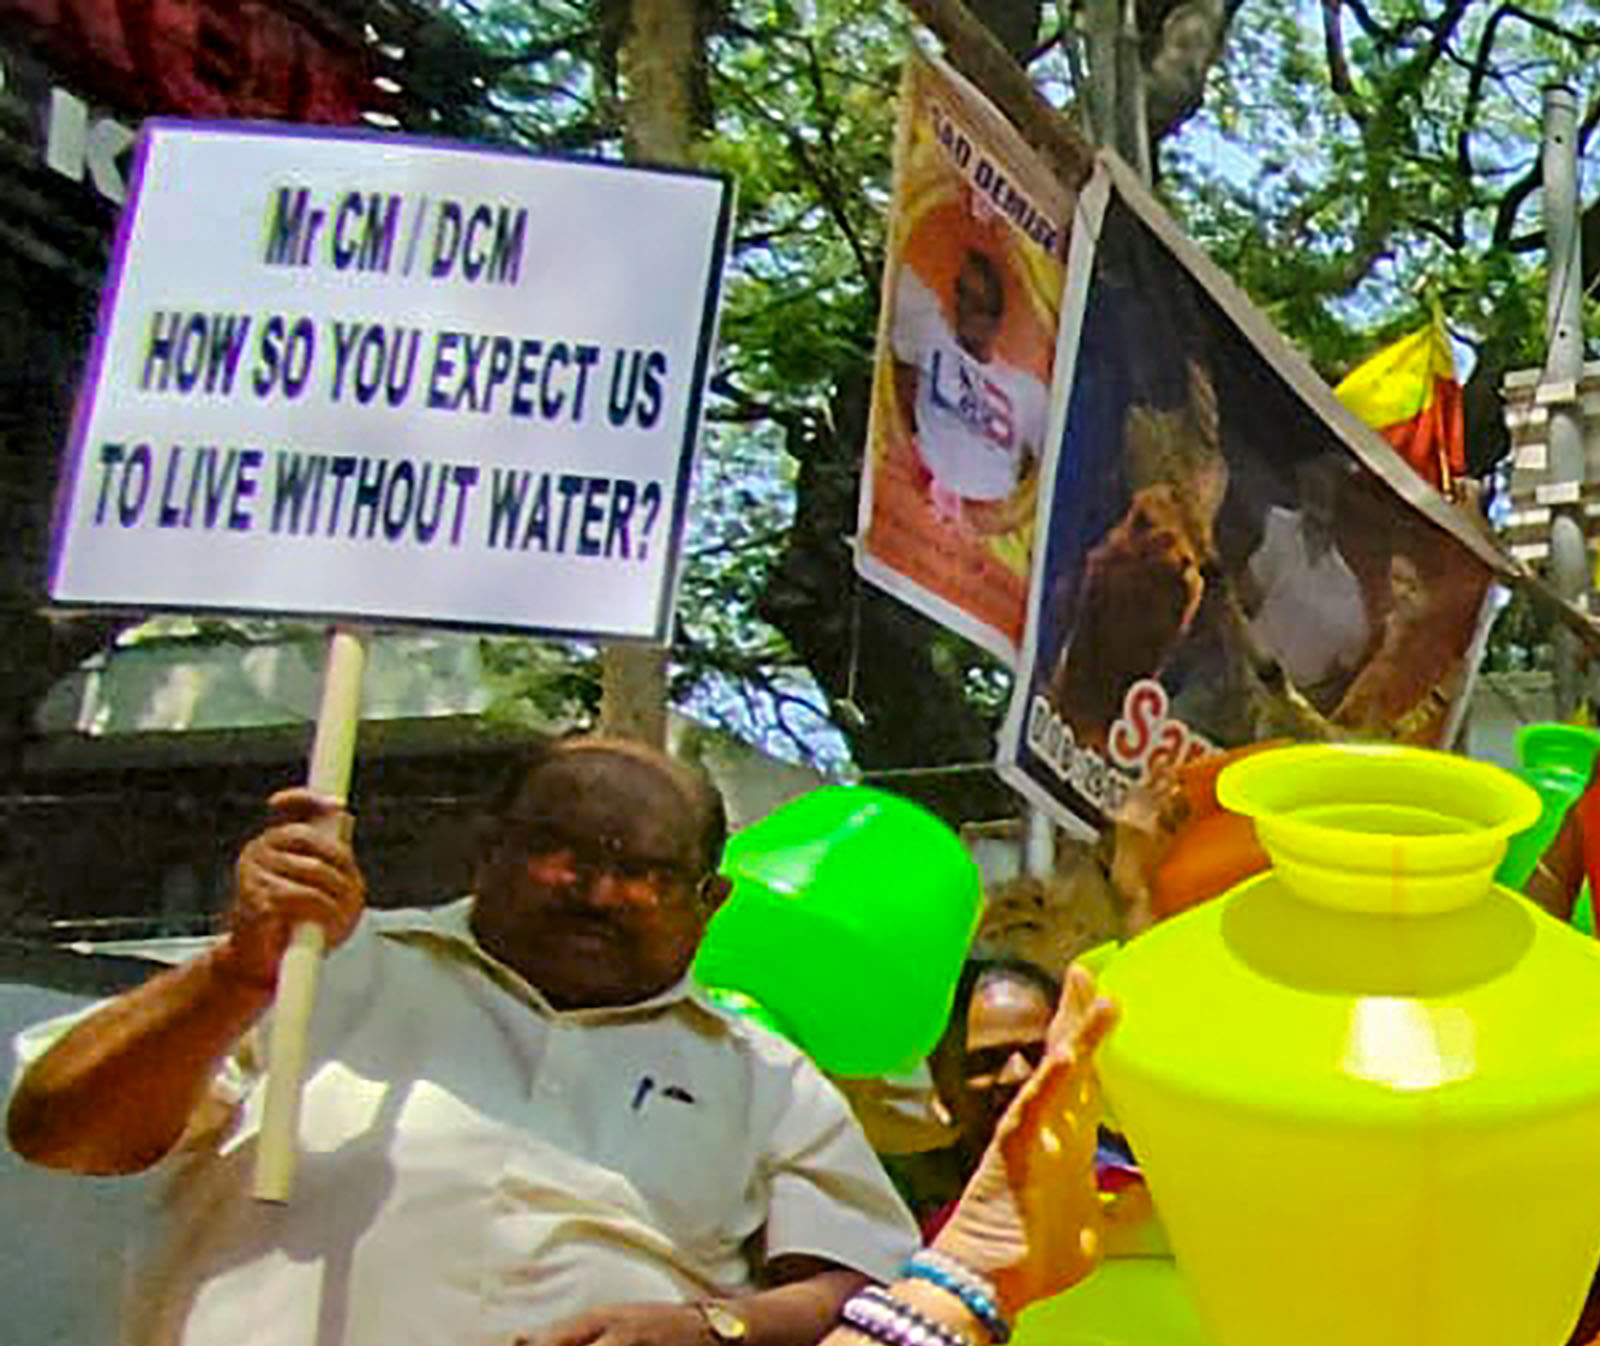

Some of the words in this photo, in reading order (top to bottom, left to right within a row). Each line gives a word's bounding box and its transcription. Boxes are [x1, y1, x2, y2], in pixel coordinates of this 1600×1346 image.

[265, 187, 325, 266] Mr
[332, 192, 401, 272] CM
[404, 194, 428, 276] /
[431, 202, 528, 284] DCM
[143, 312, 251, 394] HOW
[253, 316, 314, 399] SO
[331, 323, 421, 407] YOU
[427, 332, 600, 422] EXPECT
[608, 349, 667, 429] US
[95, 444, 151, 528] TO
[158, 447, 263, 531] LIVE
[271, 452, 479, 544] WITHOUT
[488, 469, 661, 559] WATER?
